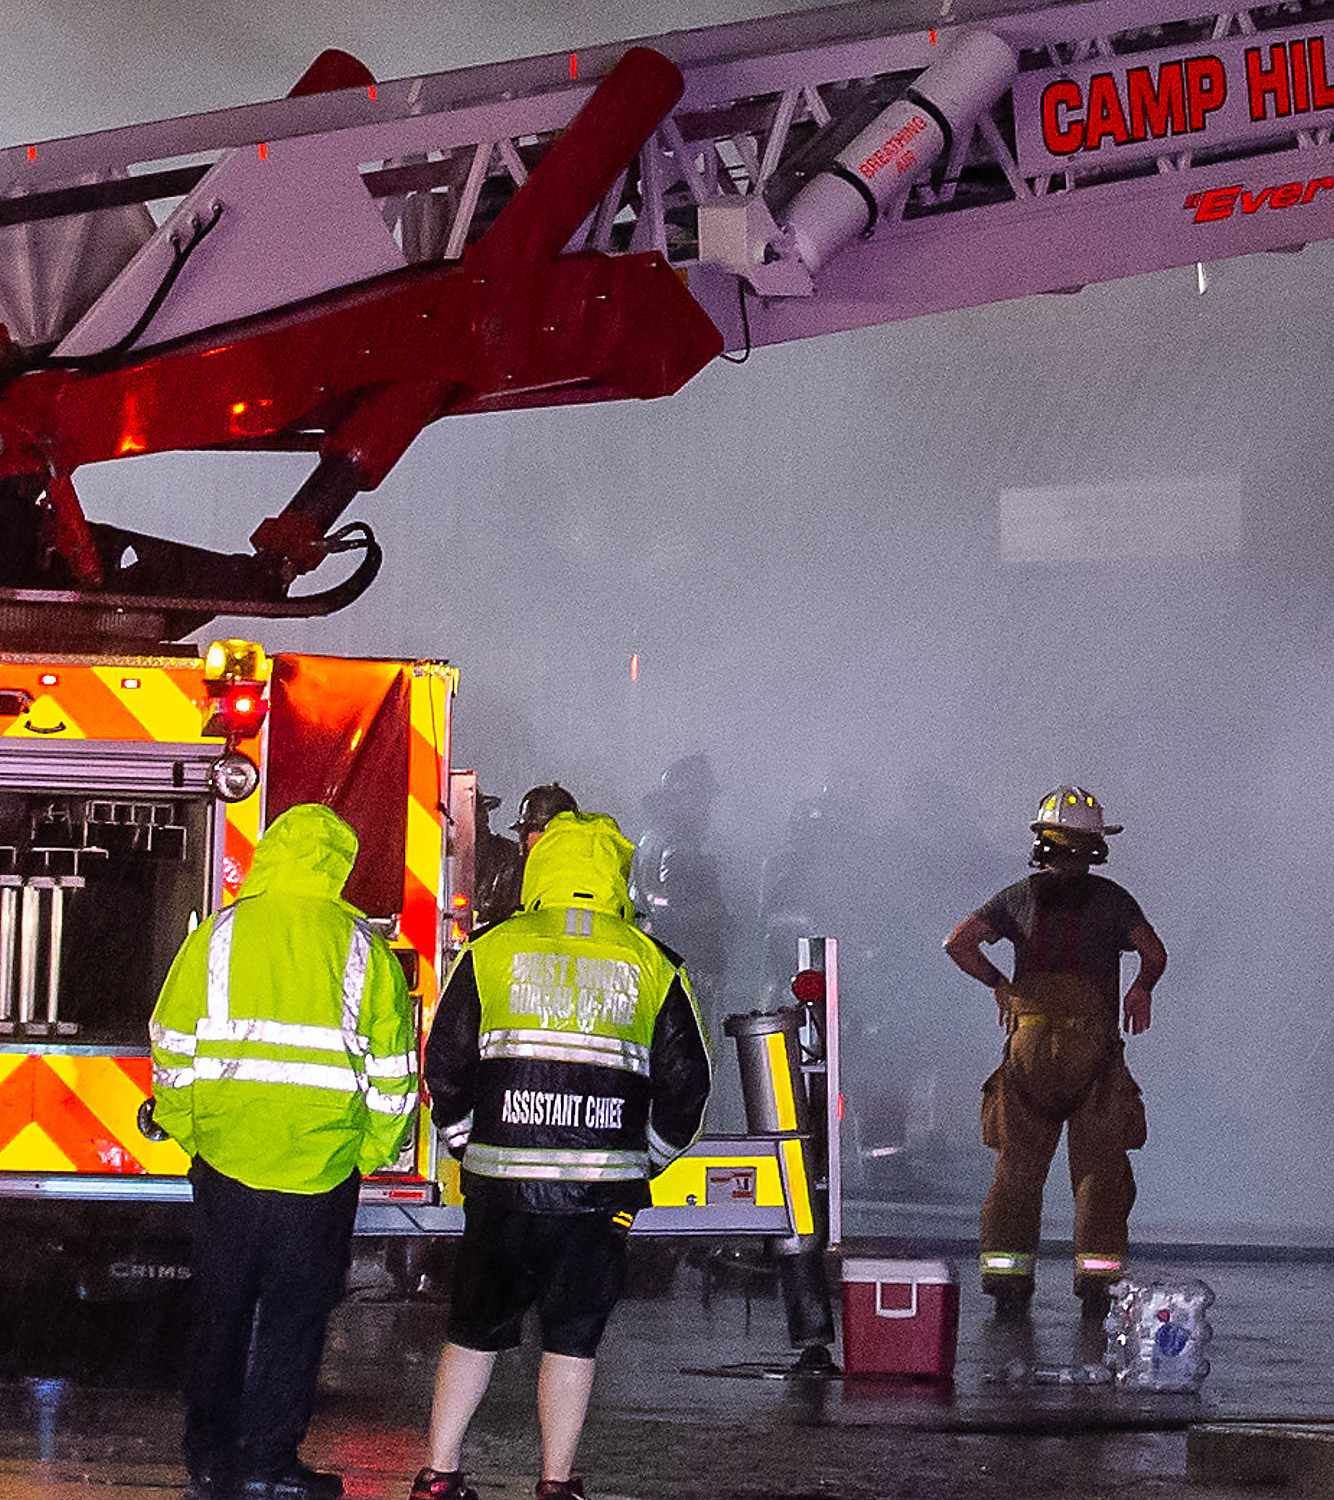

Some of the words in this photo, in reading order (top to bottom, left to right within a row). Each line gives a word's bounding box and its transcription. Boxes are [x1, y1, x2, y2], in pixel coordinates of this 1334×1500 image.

[1040, 55, 1227, 157] CAMP
[502, 1089, 583, 1127] ASSISTANT
[585, 1095, 625, 1129] CHIEF
